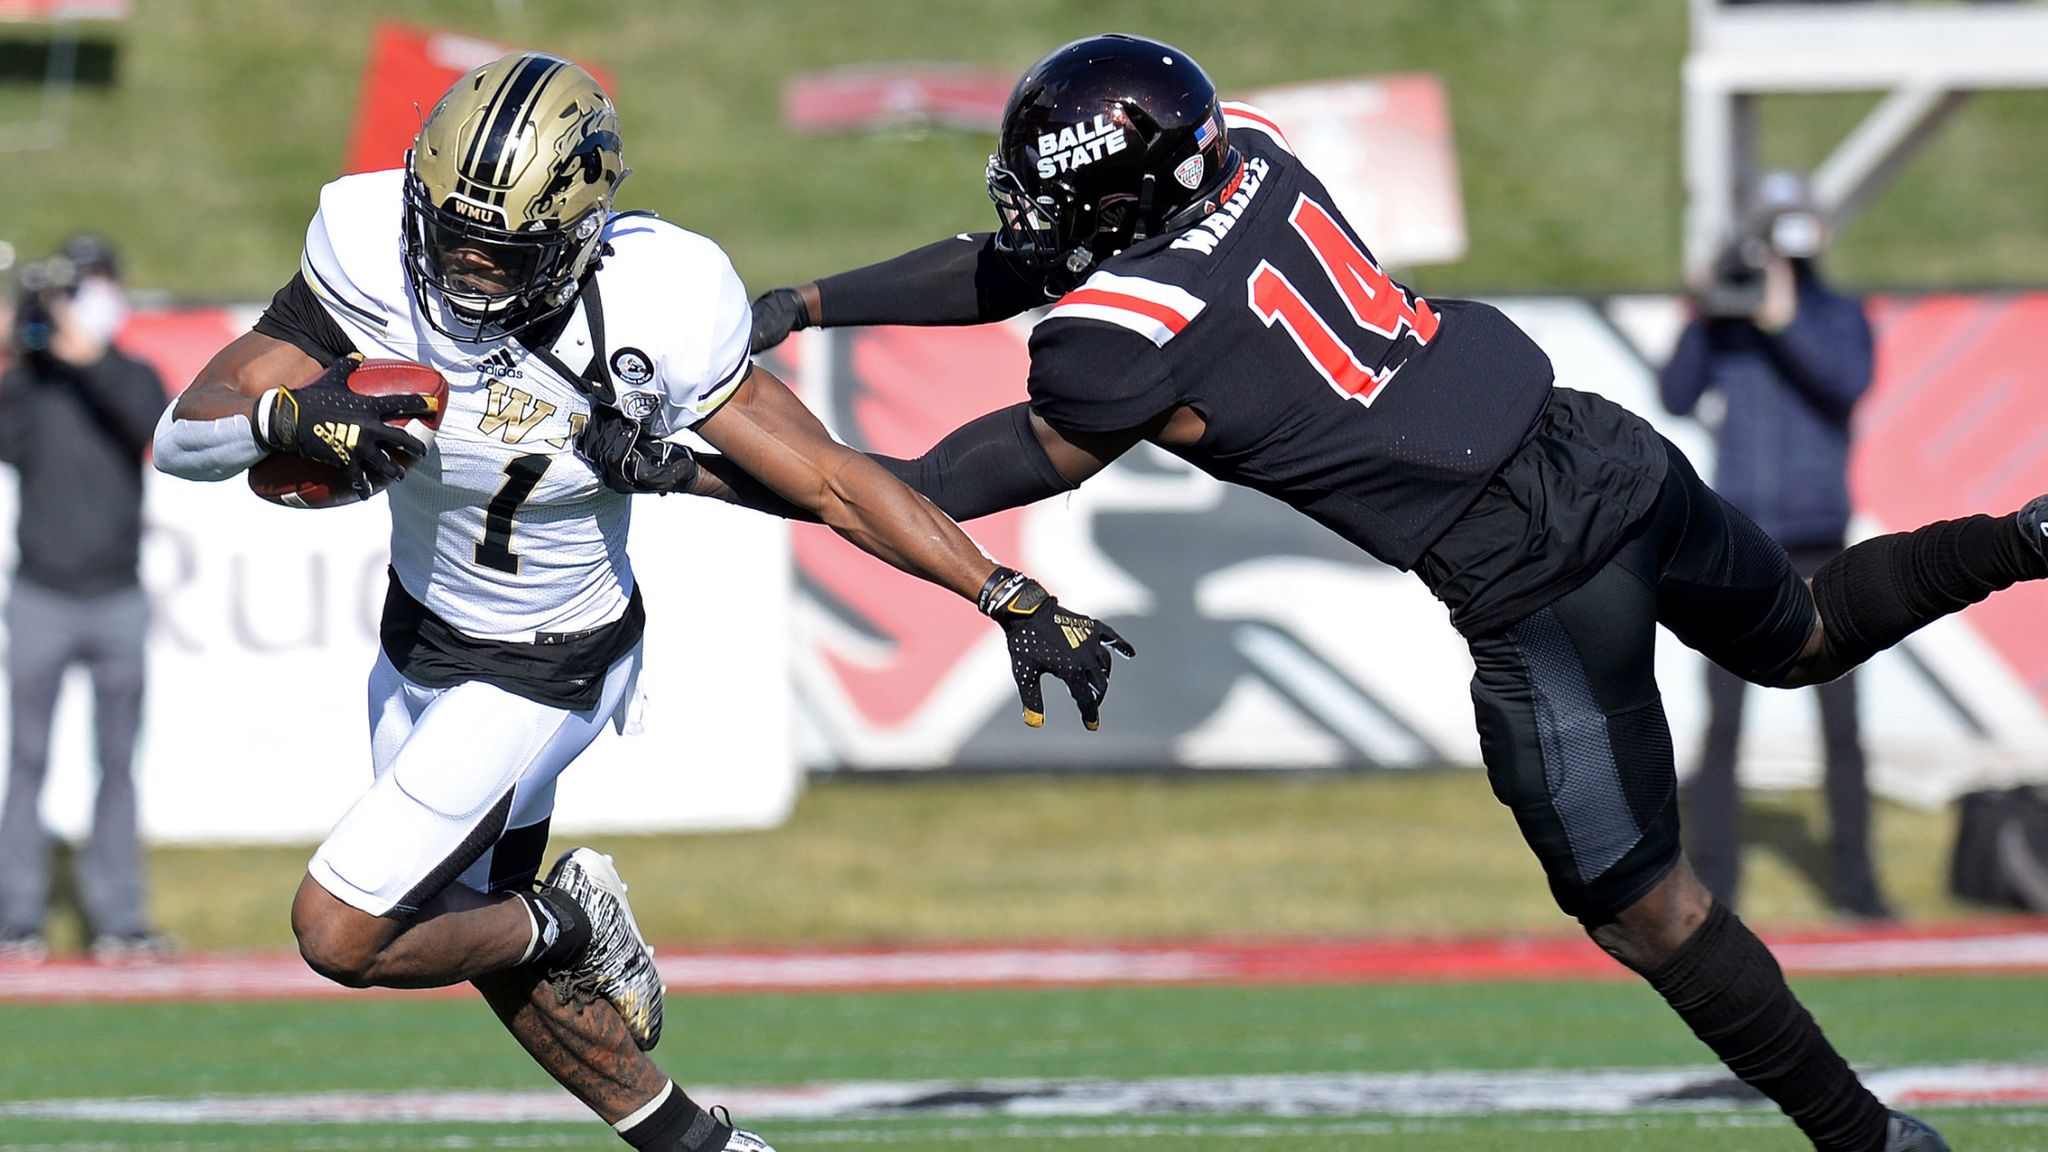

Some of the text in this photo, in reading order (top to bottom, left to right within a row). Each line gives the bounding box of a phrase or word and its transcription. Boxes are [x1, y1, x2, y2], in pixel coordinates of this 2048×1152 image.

[1036, 128, 1127, 179] STATE
[1038, 113, 1115, 157] BALL
[455, 200, 494, 223] WMU
[1248, 191, 1441, 408] 14
[476, 364, 524, 379] adidas
[472, 454, 555, 576] 1
